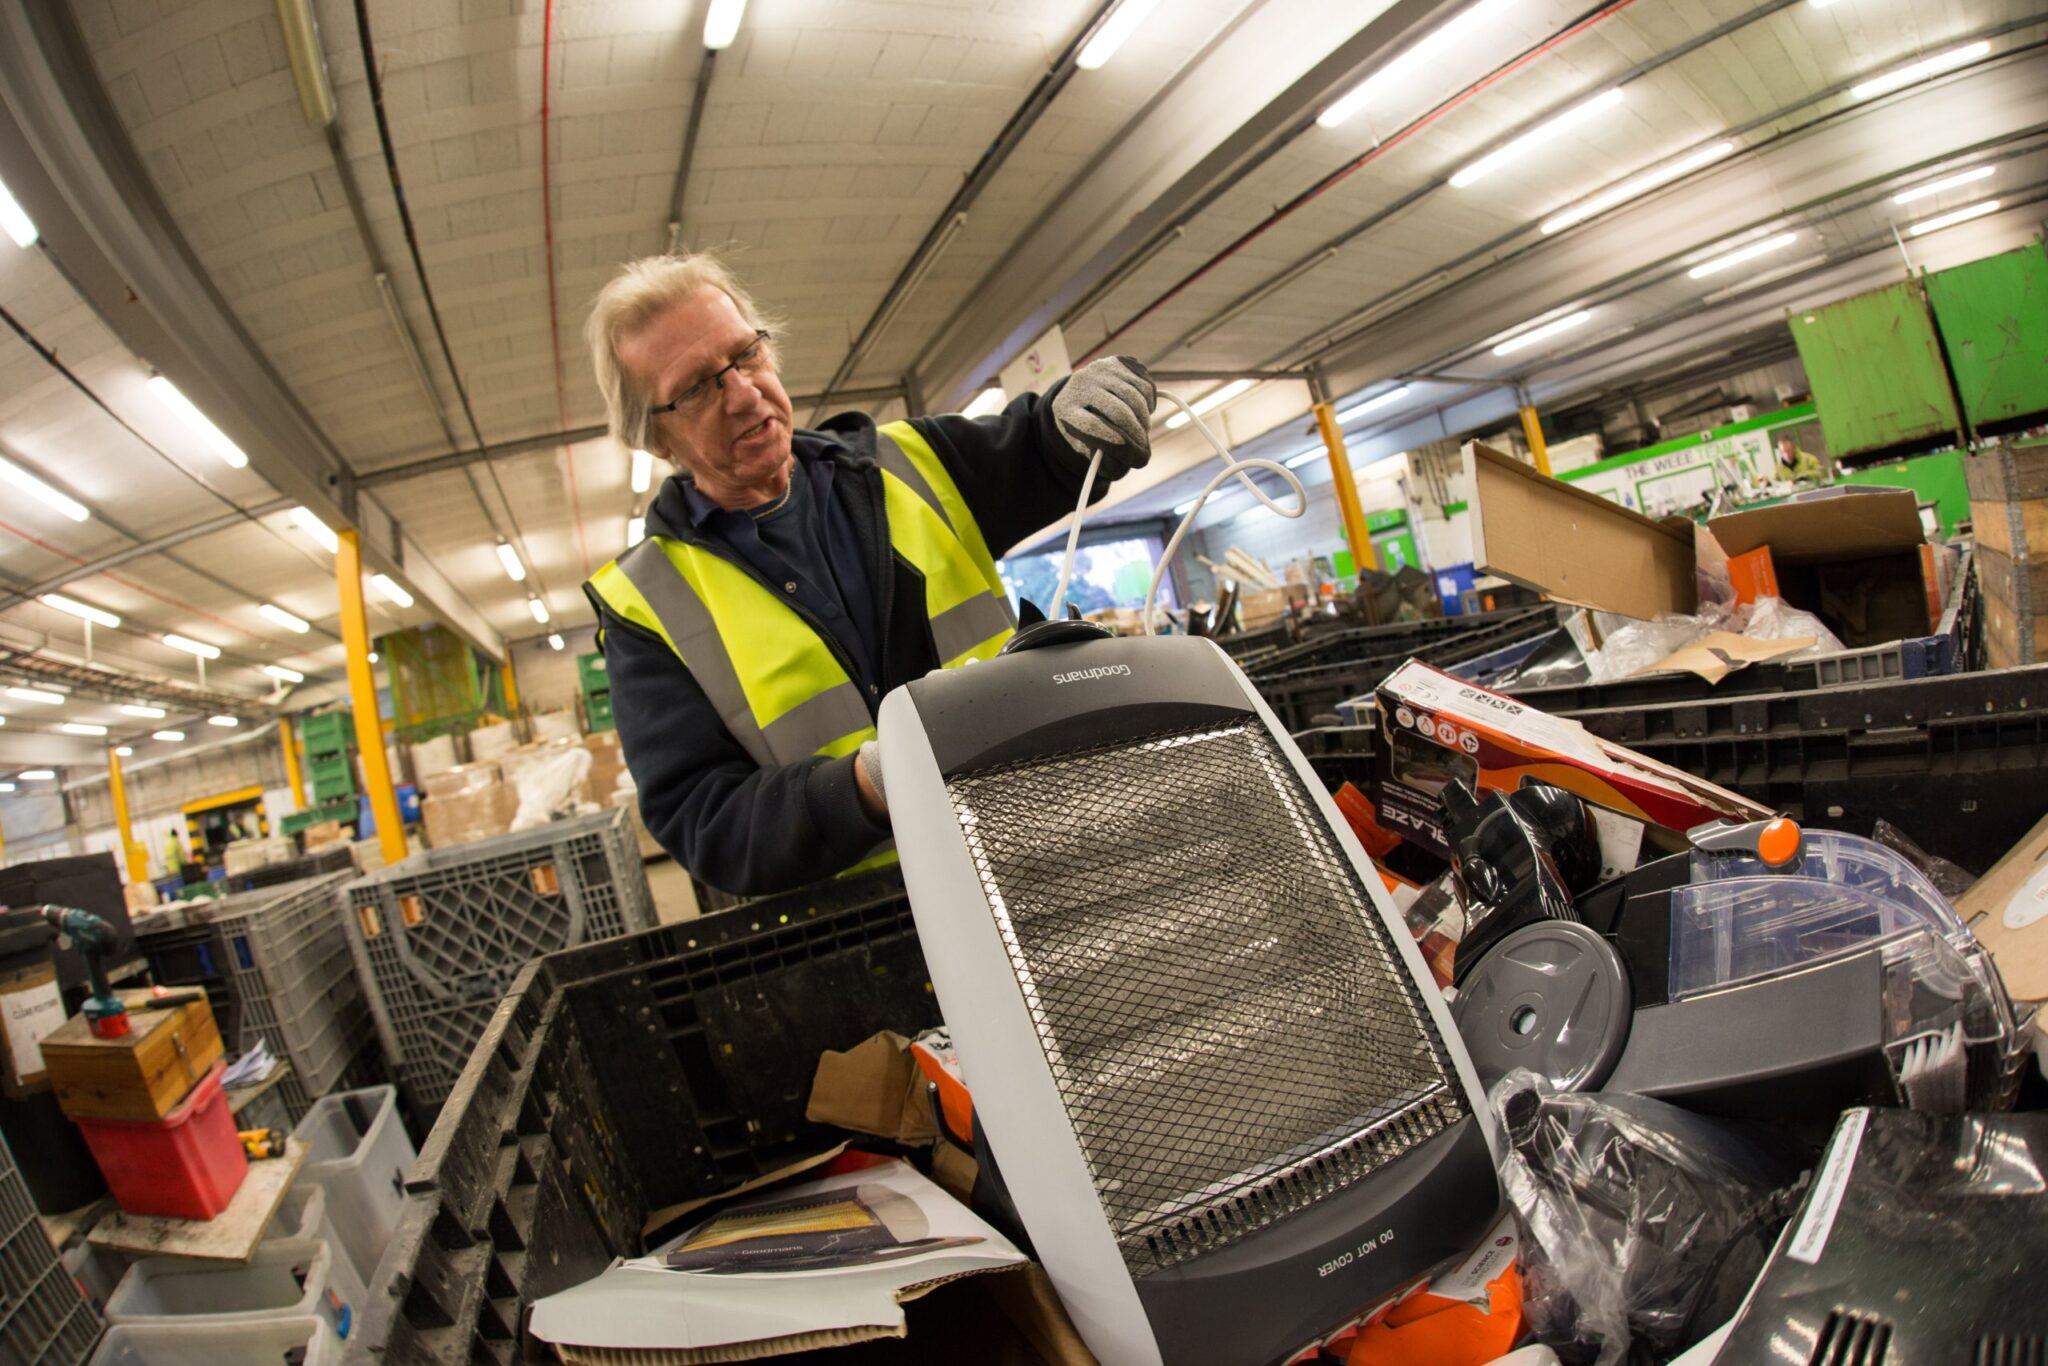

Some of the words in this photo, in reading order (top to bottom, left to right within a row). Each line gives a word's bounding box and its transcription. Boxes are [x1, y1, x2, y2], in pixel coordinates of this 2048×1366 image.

[1624, 463, 1650, 480] THE
[1653, 450, 1694, 472] WEEE
[1052, 664, 1132, 685] Goodmans
[1380, 1229, 1394, 1244] DO
[742, 1245, 803, 1254] Goodmans
[1357, 1238, 1377, 1258] NOT
[1317, 1252, 1354, 1277] COVER
[1470, 1250, 1496, 1275] SCIENCE
